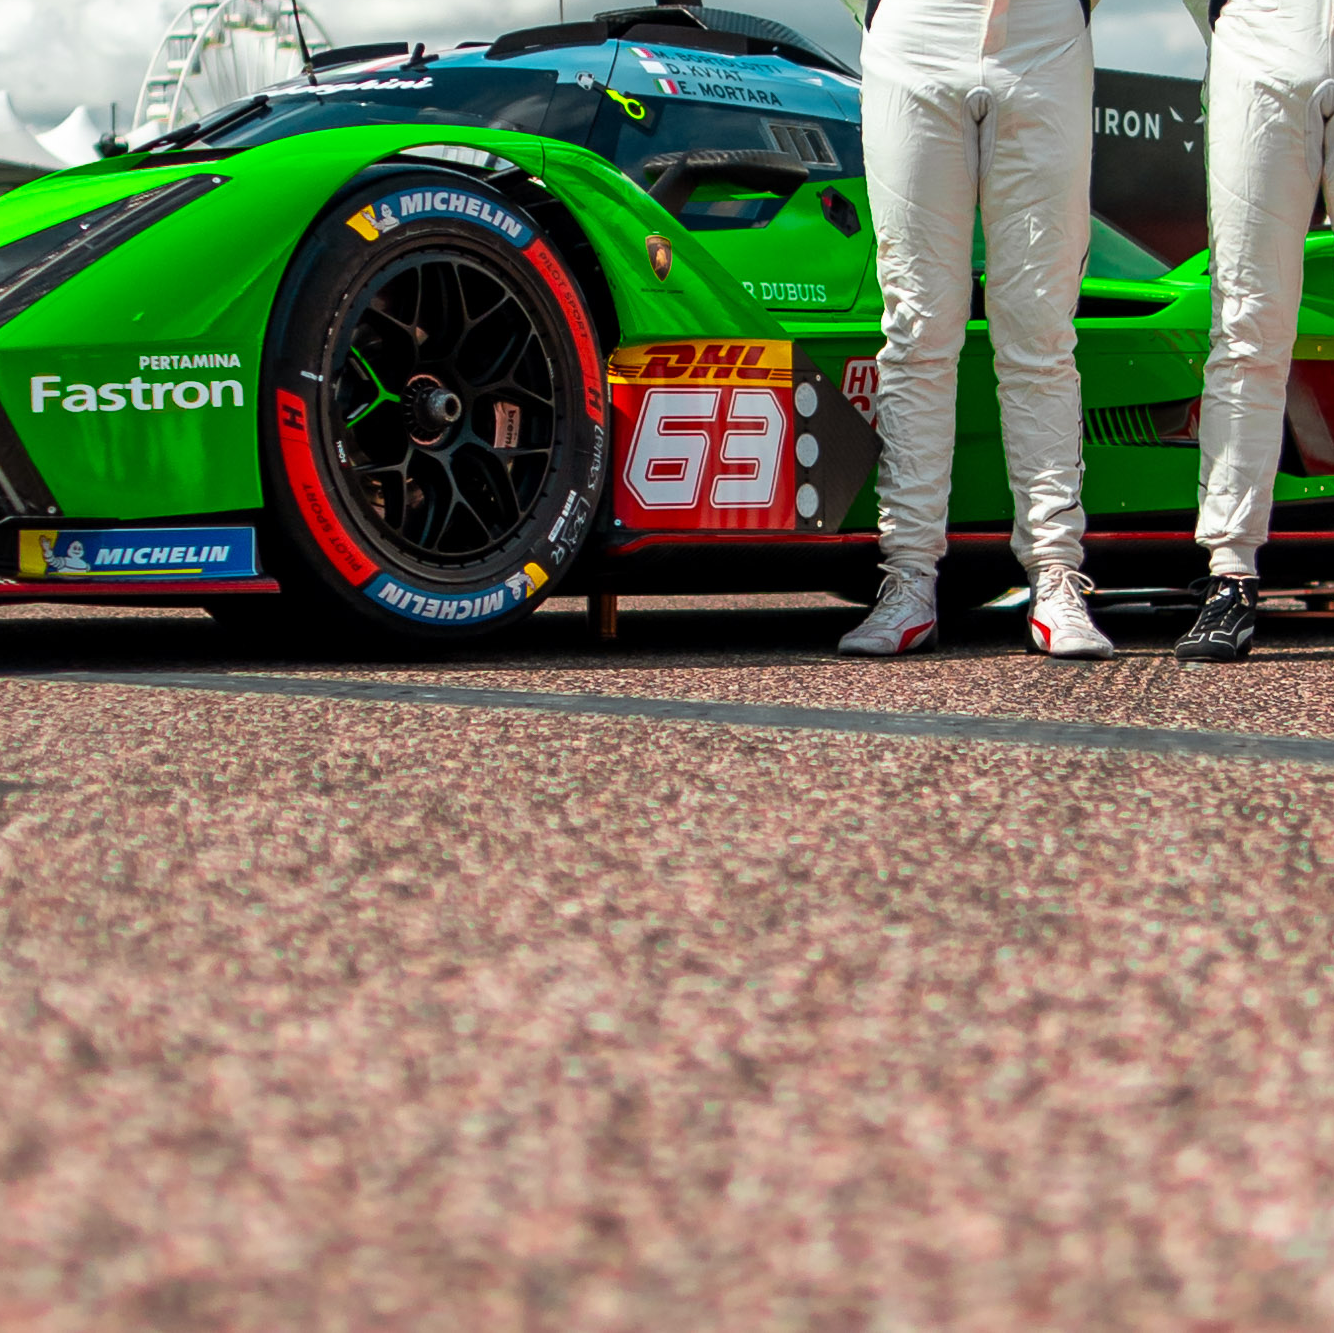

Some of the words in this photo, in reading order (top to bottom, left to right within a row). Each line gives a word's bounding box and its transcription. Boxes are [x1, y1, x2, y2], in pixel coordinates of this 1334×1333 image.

[666, 63, 687, 76] D.
[690, 63, 745, 82] KVYAT
[678, 80, 697, 96] E.
[701, 82, 783, 107] MORTARA
[1094, 107, 1161, 140] IRON
[399, 192, 525, 240] MICHELIN
[538, 251, 567, 288] PILOT
[564, 291, 588, 339] SPORT
[760, 282, 827, 303] DUBUIS
[139, 353, 241, 370] PERTAMINA
[638, 344, 766, 380] DHL
[30, 375, 244, 413] Fastron
[587, 386, 602, 413] H
[281, 403, 305, 431] H
[622, 387, 787, 510] 63
[301, 482, 334, 532] SPORT
[95, 545, 230, 565] MICHELIN
[328, 535, 363, 573] PILOT
[377, 580, 506, 622] MICHELIN
